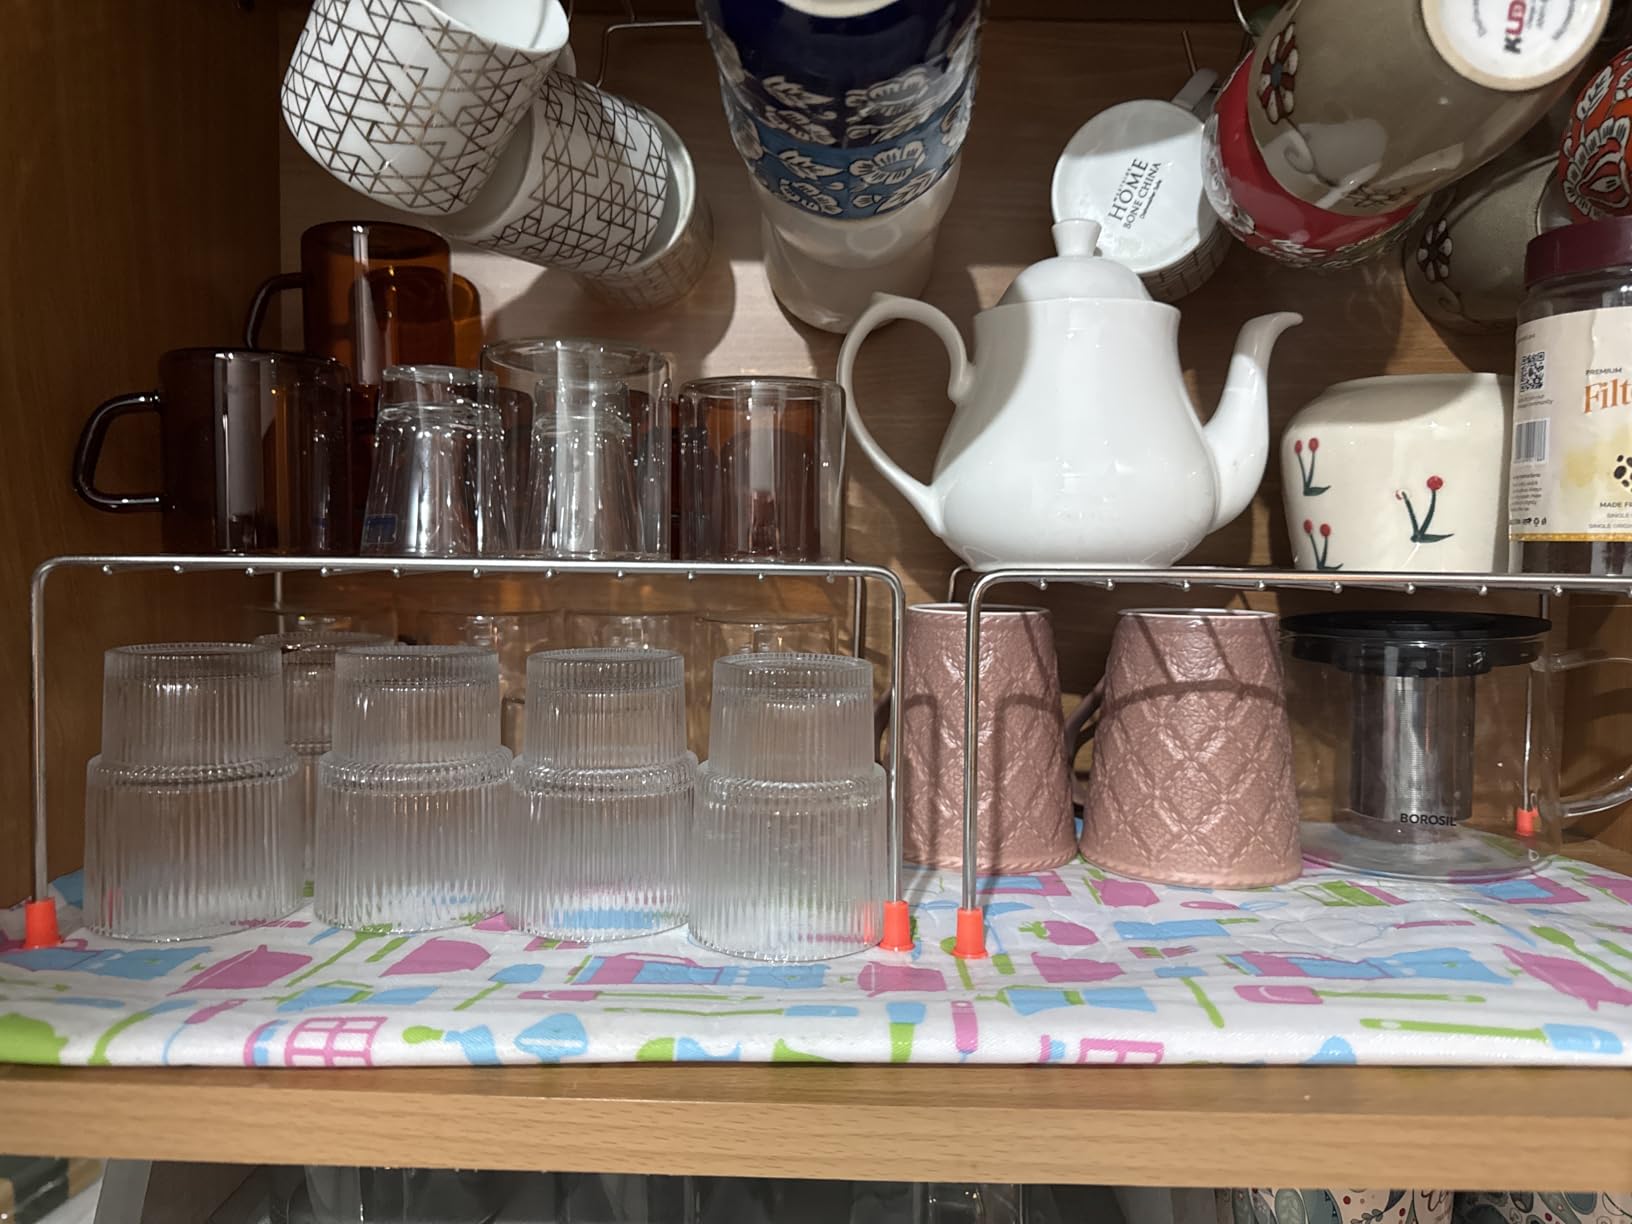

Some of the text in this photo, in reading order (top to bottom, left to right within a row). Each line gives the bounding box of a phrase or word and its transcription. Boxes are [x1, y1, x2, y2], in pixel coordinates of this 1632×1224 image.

[1108, 158, 1149, 222] HOME
[1123, 162, 1162, 229] BONE CHINA
[1585, 367, 1623, 375] PREMIUM
[1584, 378, 1632, 414] Filt
[1400, 813, 1457, 826] BOROSIL
